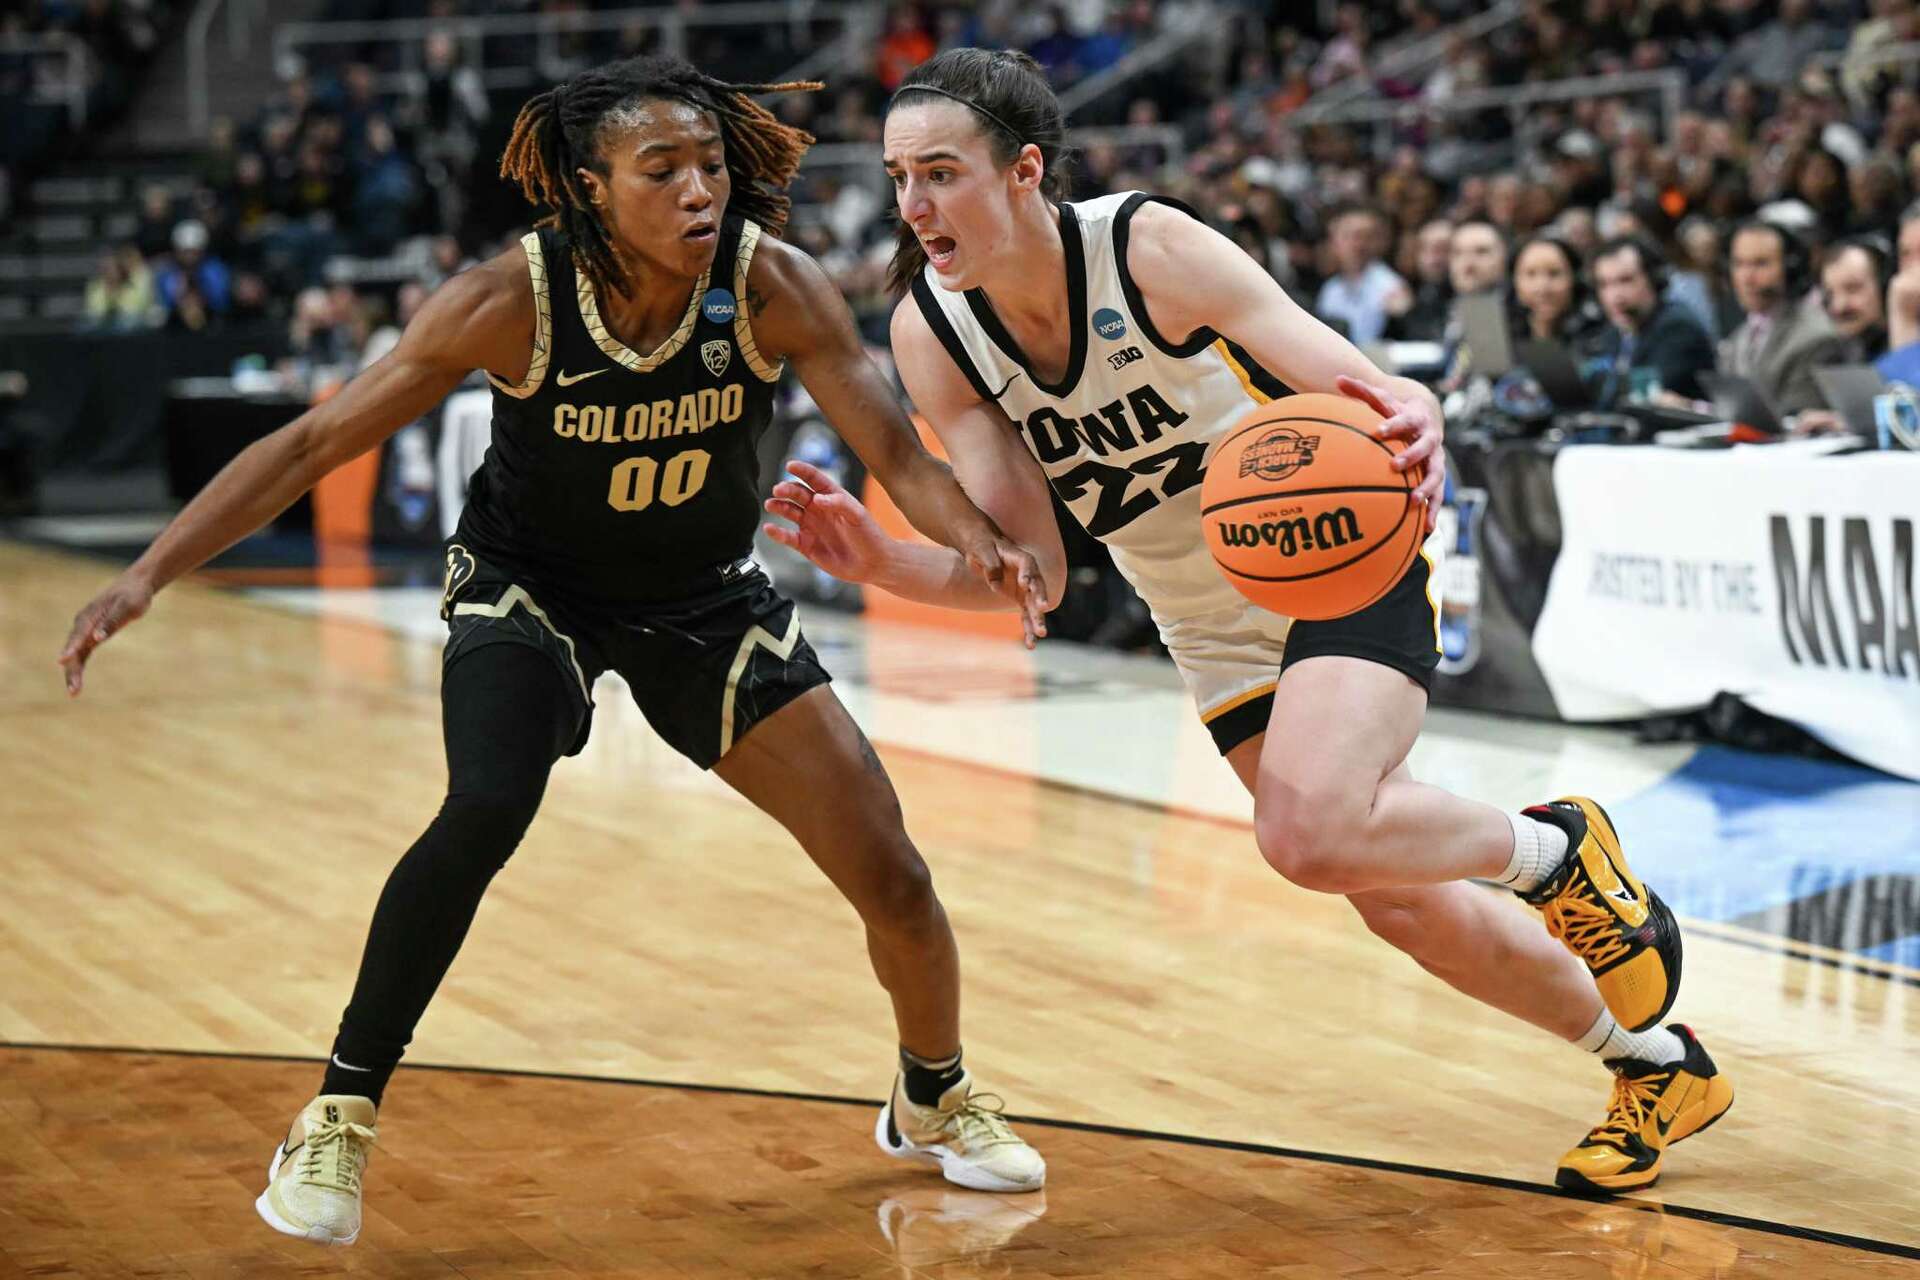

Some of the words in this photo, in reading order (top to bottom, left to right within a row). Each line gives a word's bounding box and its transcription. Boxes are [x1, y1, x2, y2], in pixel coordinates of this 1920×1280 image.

[707, 304, 735, 315] NCAA
[1098, 319, 1125, 335] NCAA
[553, 383, 744, 444] COLORADO
[1013, 384, 1190, 464] OWA
[607, 448, 712, 513] 00
[1051, 440, 1210, 537] 22
[1218, 506, 1364, 557] Wilson
[1710, 562, 1763, 616] THE
